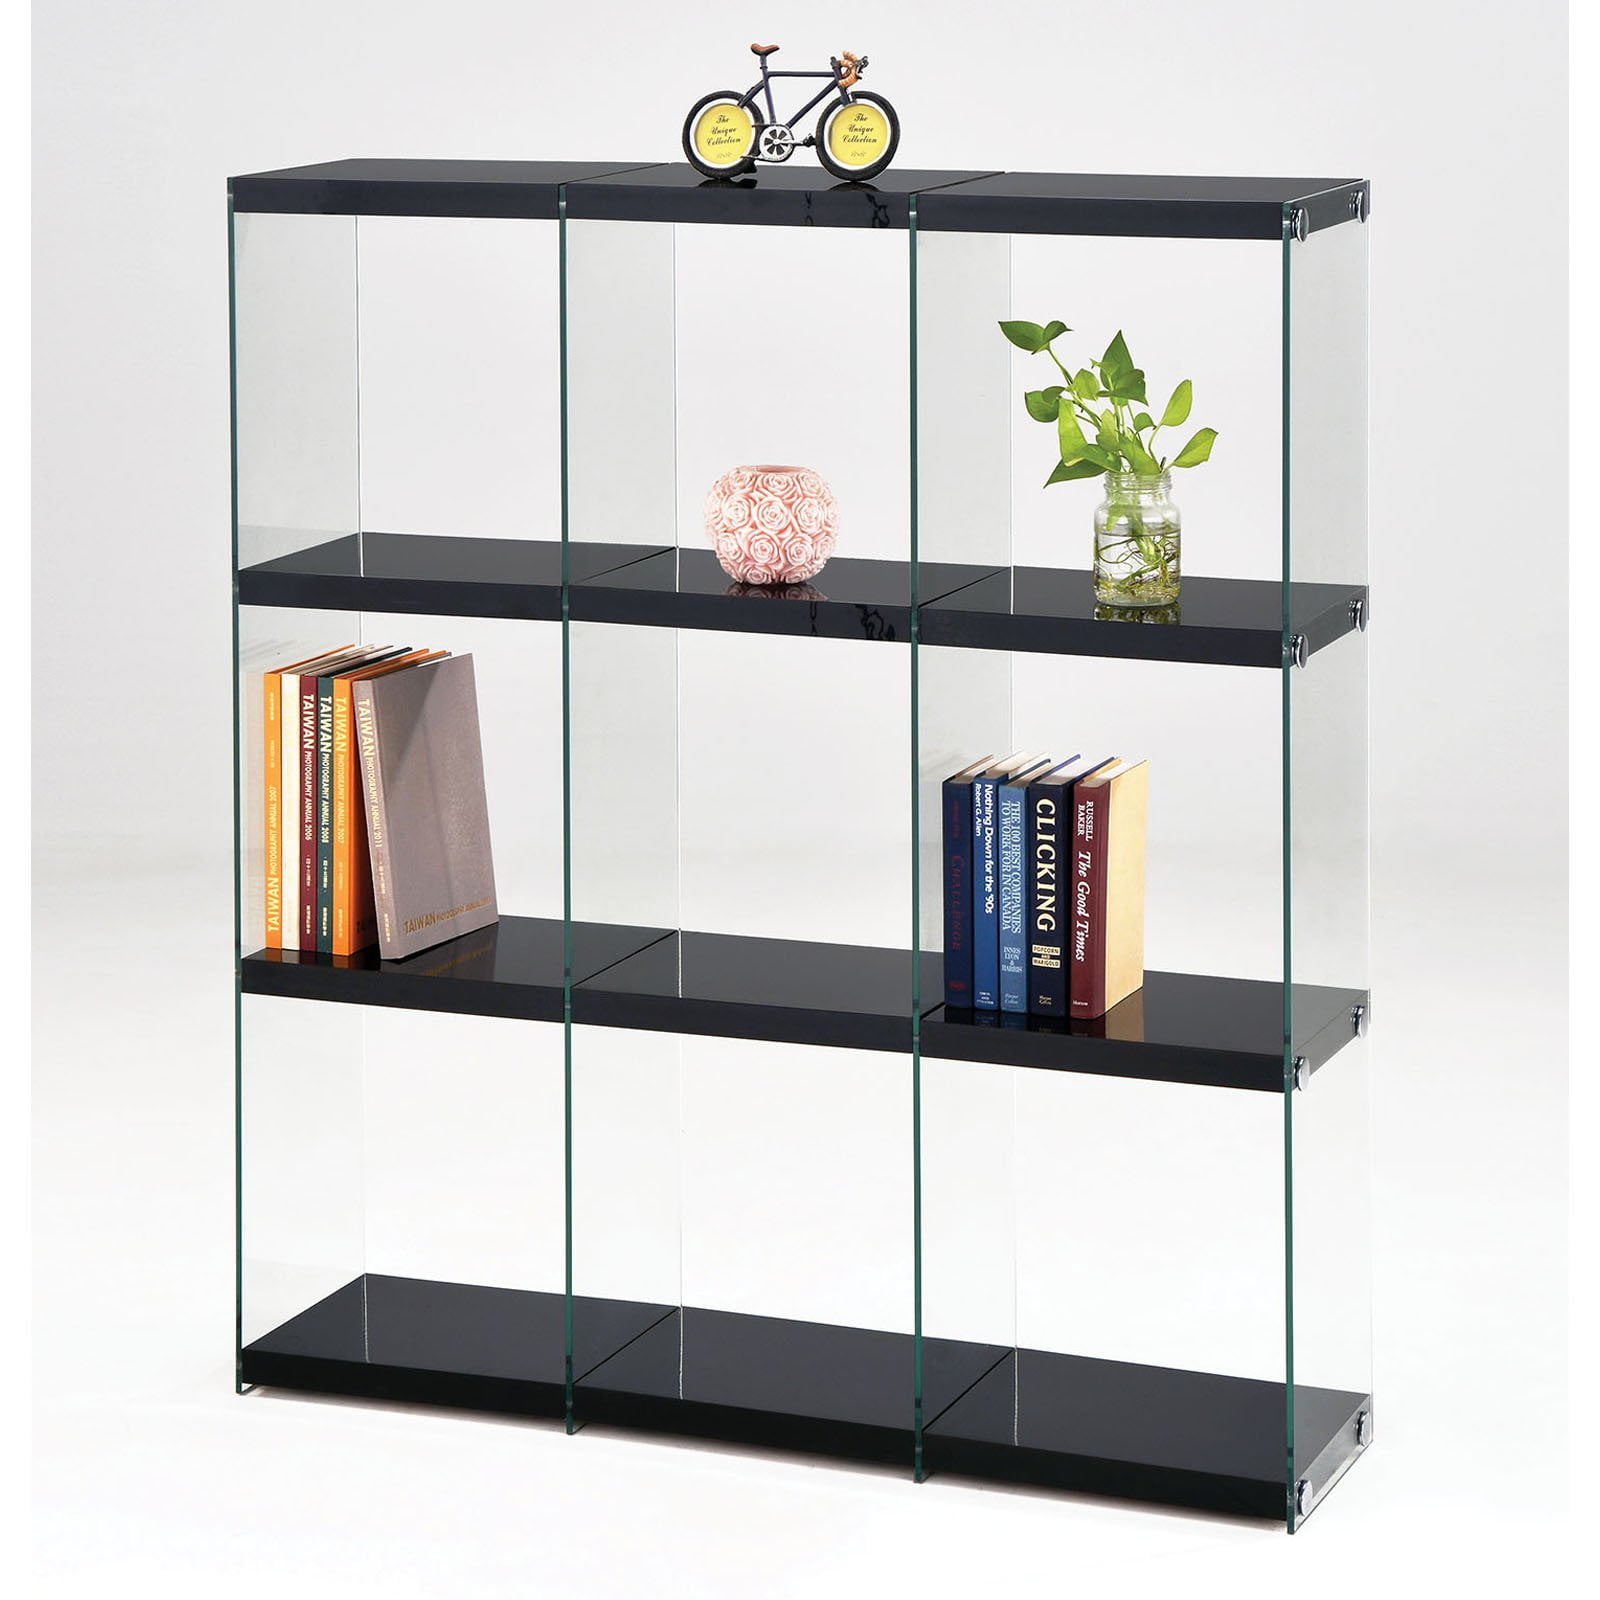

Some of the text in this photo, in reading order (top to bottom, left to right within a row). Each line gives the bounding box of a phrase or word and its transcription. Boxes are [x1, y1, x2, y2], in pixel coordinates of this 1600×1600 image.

[711, 127, 736, 137] Unique
[716, 115, 729, 123] The
[848, 124, 874, 135] Unique
[854, 113, 868, 122] The
[707, 136, 741, 146] Collection
[842, 134, 878, 144] Collection
[320, 696, 331, 752] TAIWAN
[335, 697, 347, 752] TAIWAN
[303, 694, 314, 840] TAIWAN PHOTOGRAPHY ANNUAL 2006
[321, 753, 329, 799] PHOTOGRAPHY
[358, 699, 383, 848] TAIWAN PHOTOGRAPHY ANNUAL 2011
[269, 803, 277, 828] ANNUAL
[321, 800, 329, 826] ANNUAL
[337, 801, 345, 827] ANNUAL
[1077, 804, 1085, 836] BAKER
[1085, 800, 1094, 841] RUSSELL
[269, 829, 277, 875] PHOTOGRAPHY
[983, 784, 994, 914] Nothing Down for the '90s
[1002, 800, 1011, 930] TO WORK FOR IN CANADA
[1011, 801, 1021, 933] THE 100 BEST COMPANIES
[1036, 799, 1055, 932] CLICKING
[268, 877, 279, 931] TAIWAN
[1075, 851, 1091, 962] The Good Times
[404, 912, 436, 935] TAIWAN
[1033, 946, 1059, 954] POPCORN
[1033, 958, 1059, 967] MARIGOLD
